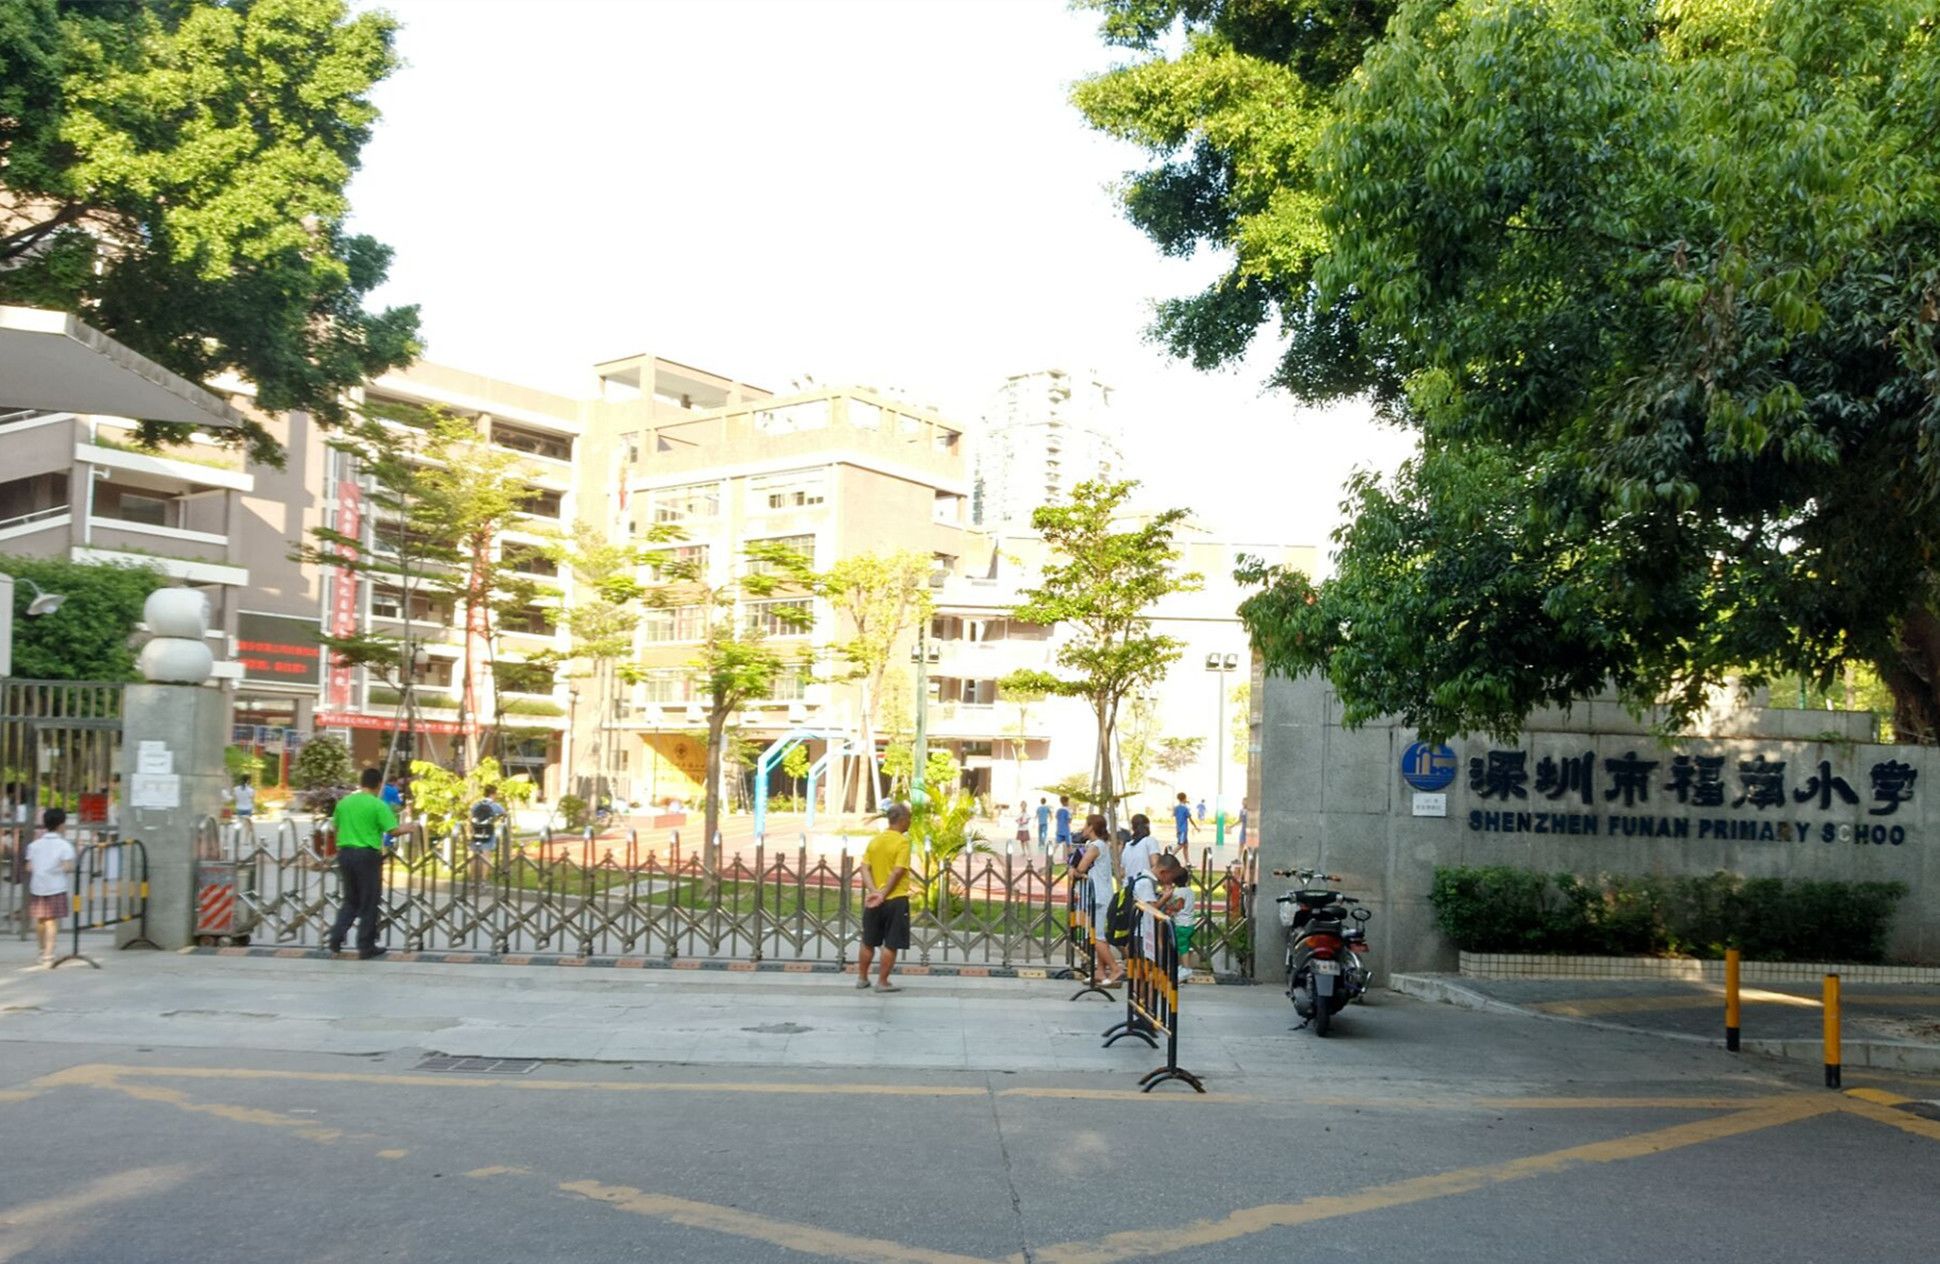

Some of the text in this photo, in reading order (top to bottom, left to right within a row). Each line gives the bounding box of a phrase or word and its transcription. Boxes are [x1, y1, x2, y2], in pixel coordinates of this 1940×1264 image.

[1469, 810, 1905, 846] SHENZHEN FUNAN PRIMARY SCHOO
